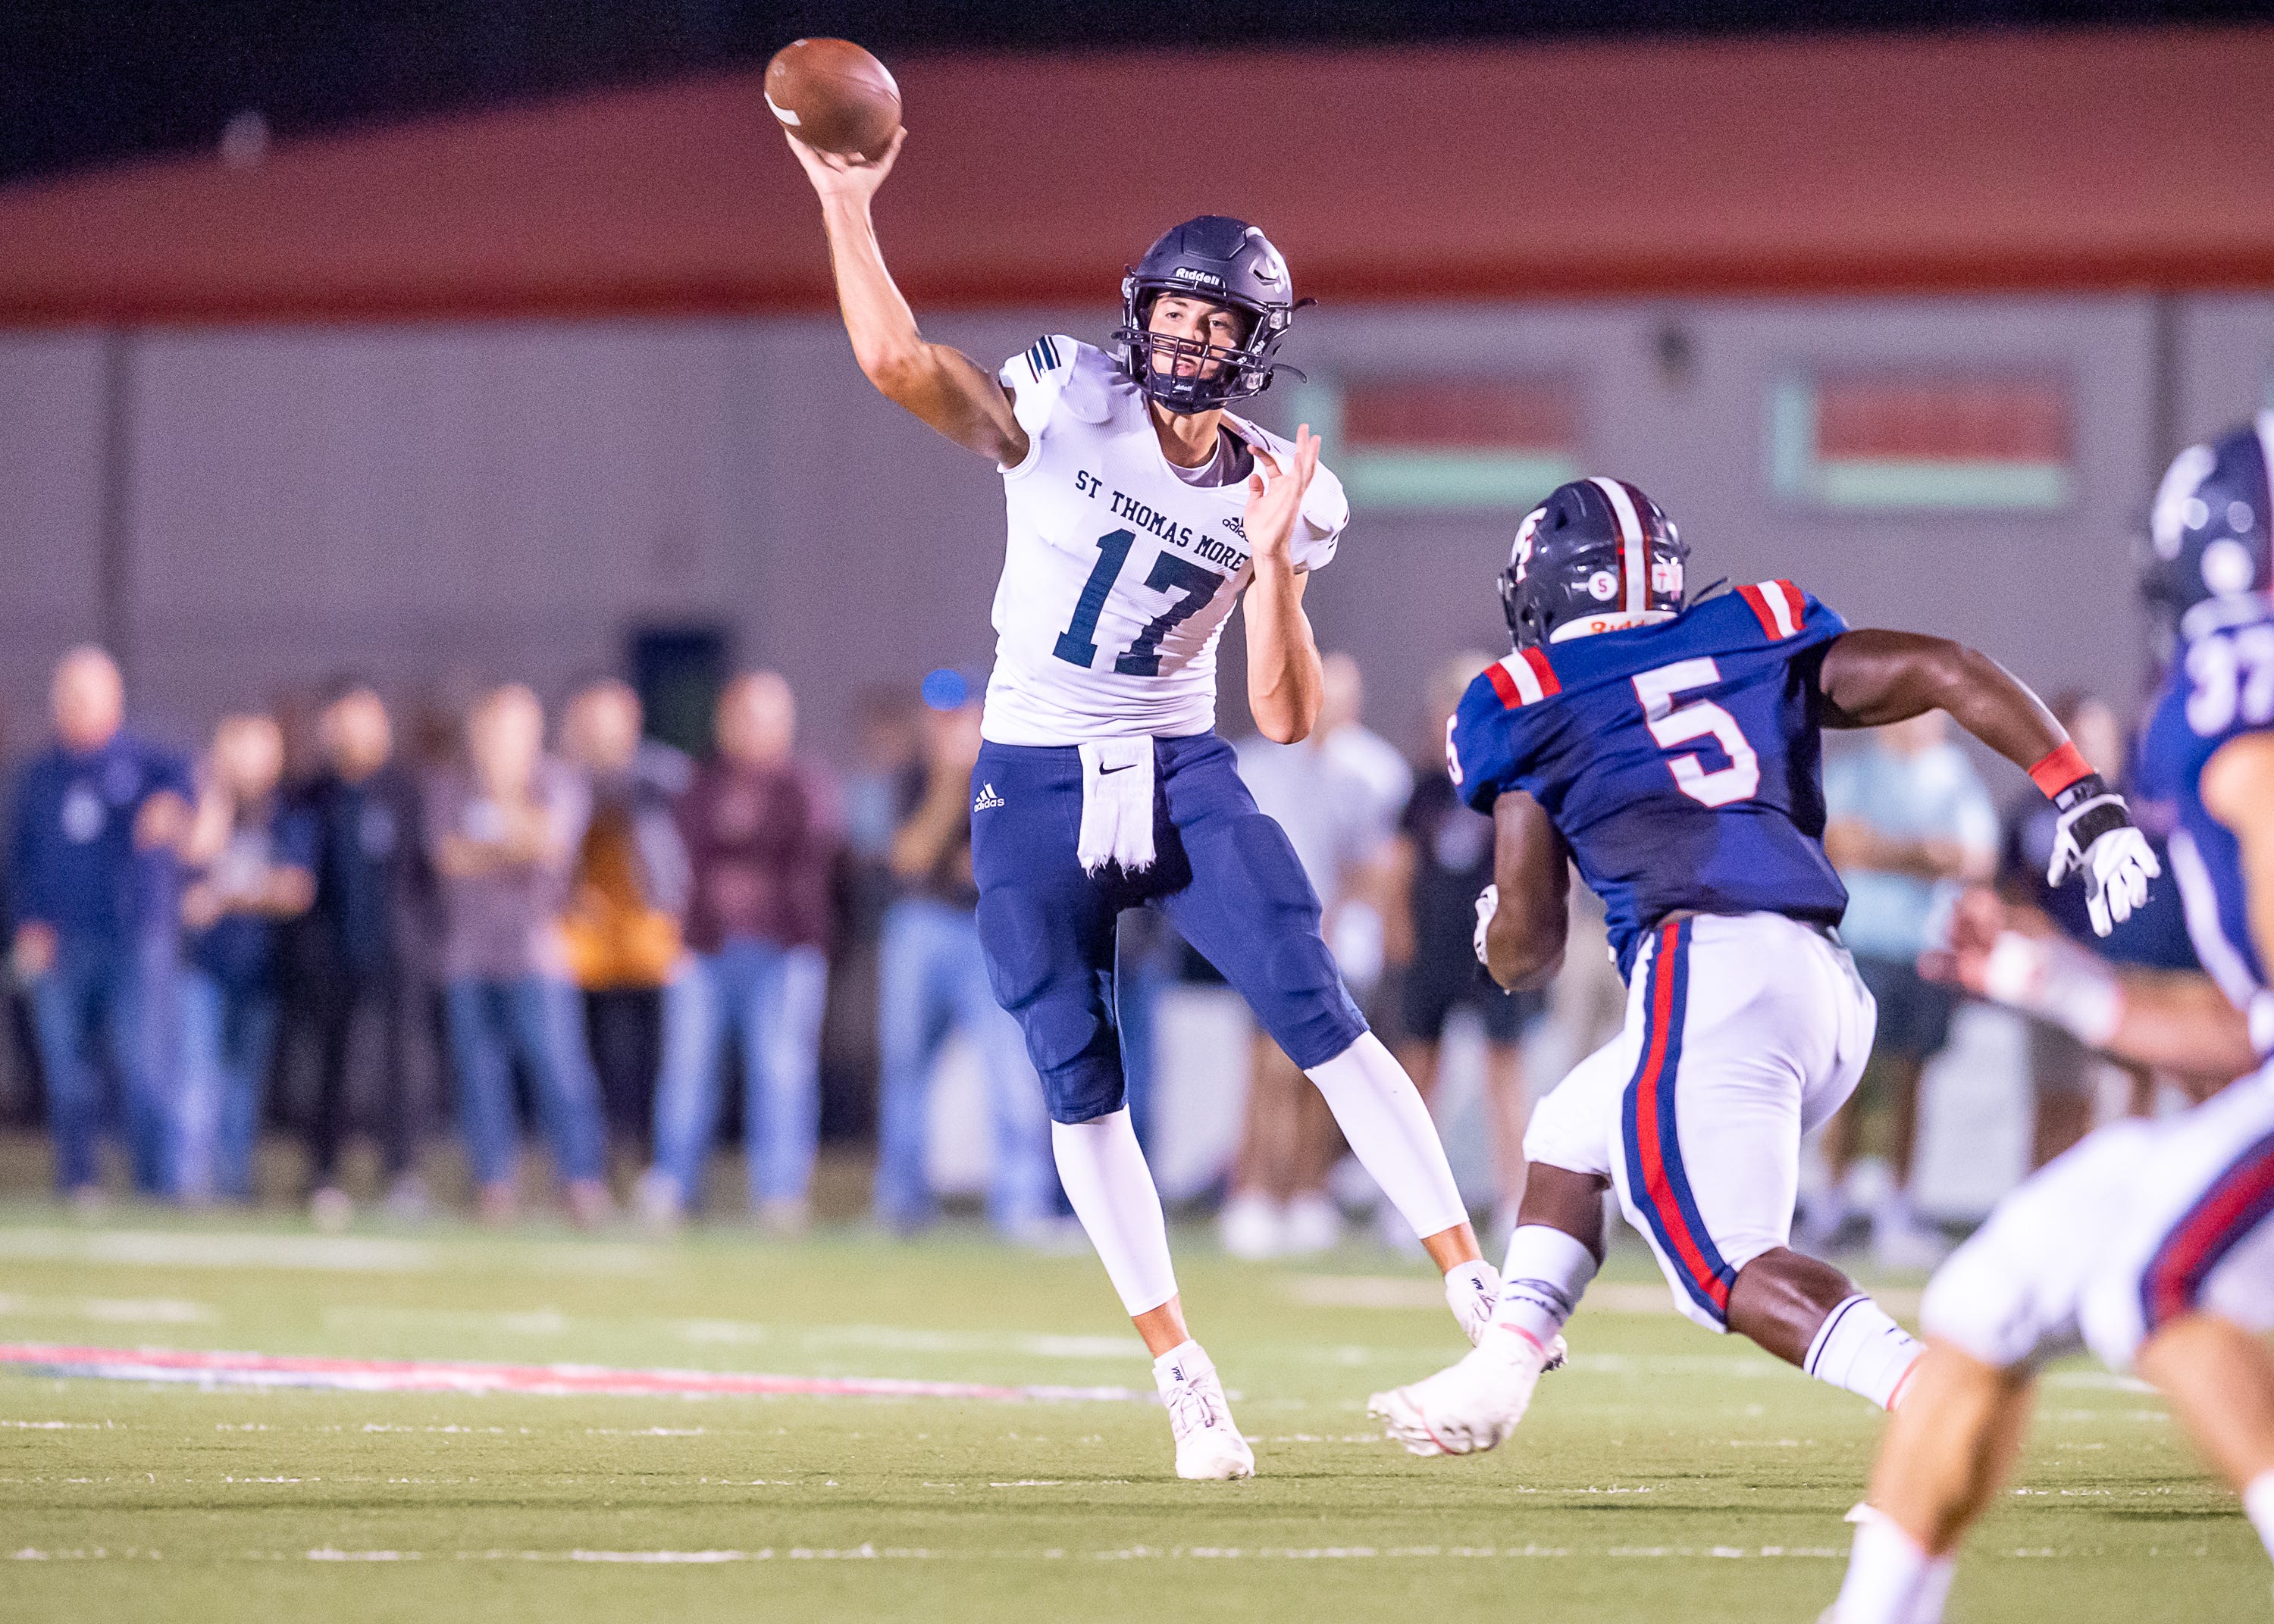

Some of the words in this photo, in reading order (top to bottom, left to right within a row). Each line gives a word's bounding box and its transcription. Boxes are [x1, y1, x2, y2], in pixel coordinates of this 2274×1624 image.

[1176, 268, 1220, 286] Riddell
[1075, 469, 1103, 499] ST
[1110, 490, 1193, 548] THOMAS
[1193, 534, 1250, 572] MORE
[1052, 527, 1226, 677] 17
[1630, 656, 1761, 809] 5
[973, 798, 1005, 813] adidas
